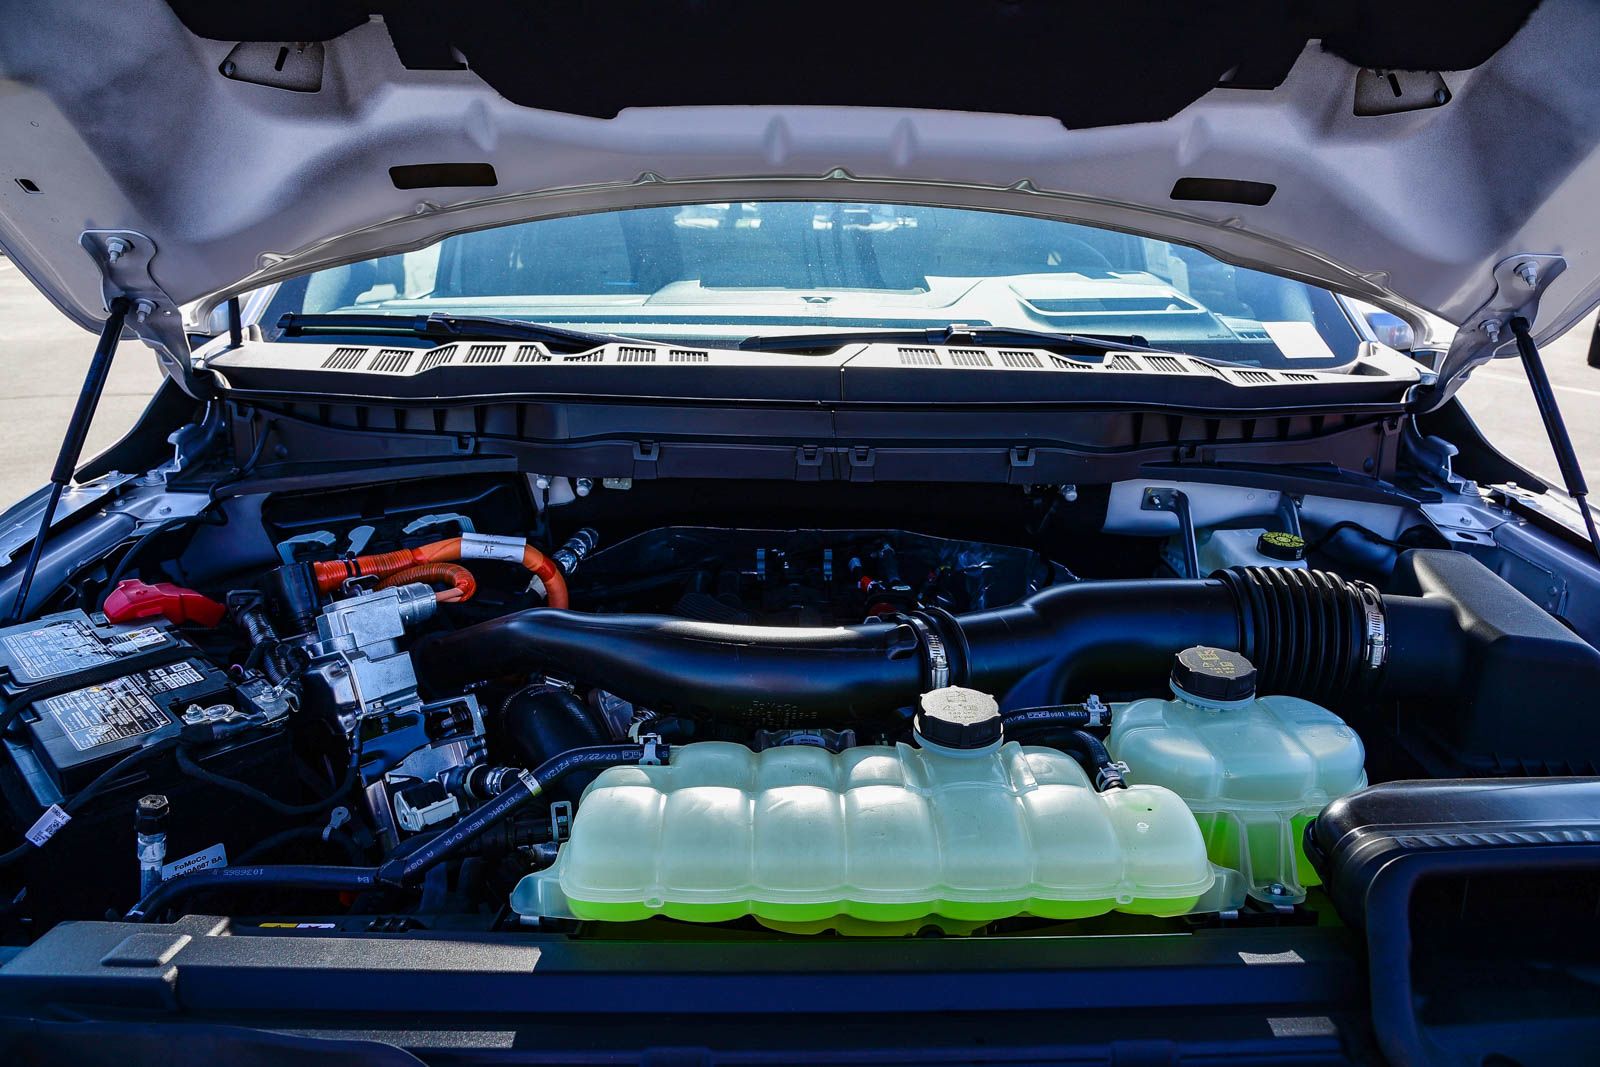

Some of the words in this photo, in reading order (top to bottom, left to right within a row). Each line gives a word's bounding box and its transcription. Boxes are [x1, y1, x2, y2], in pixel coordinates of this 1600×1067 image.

[483, 545, 495, 555] AF
[465, 819, 486, 833] MEX
[174, 855, 206, 870] FoMoCo
